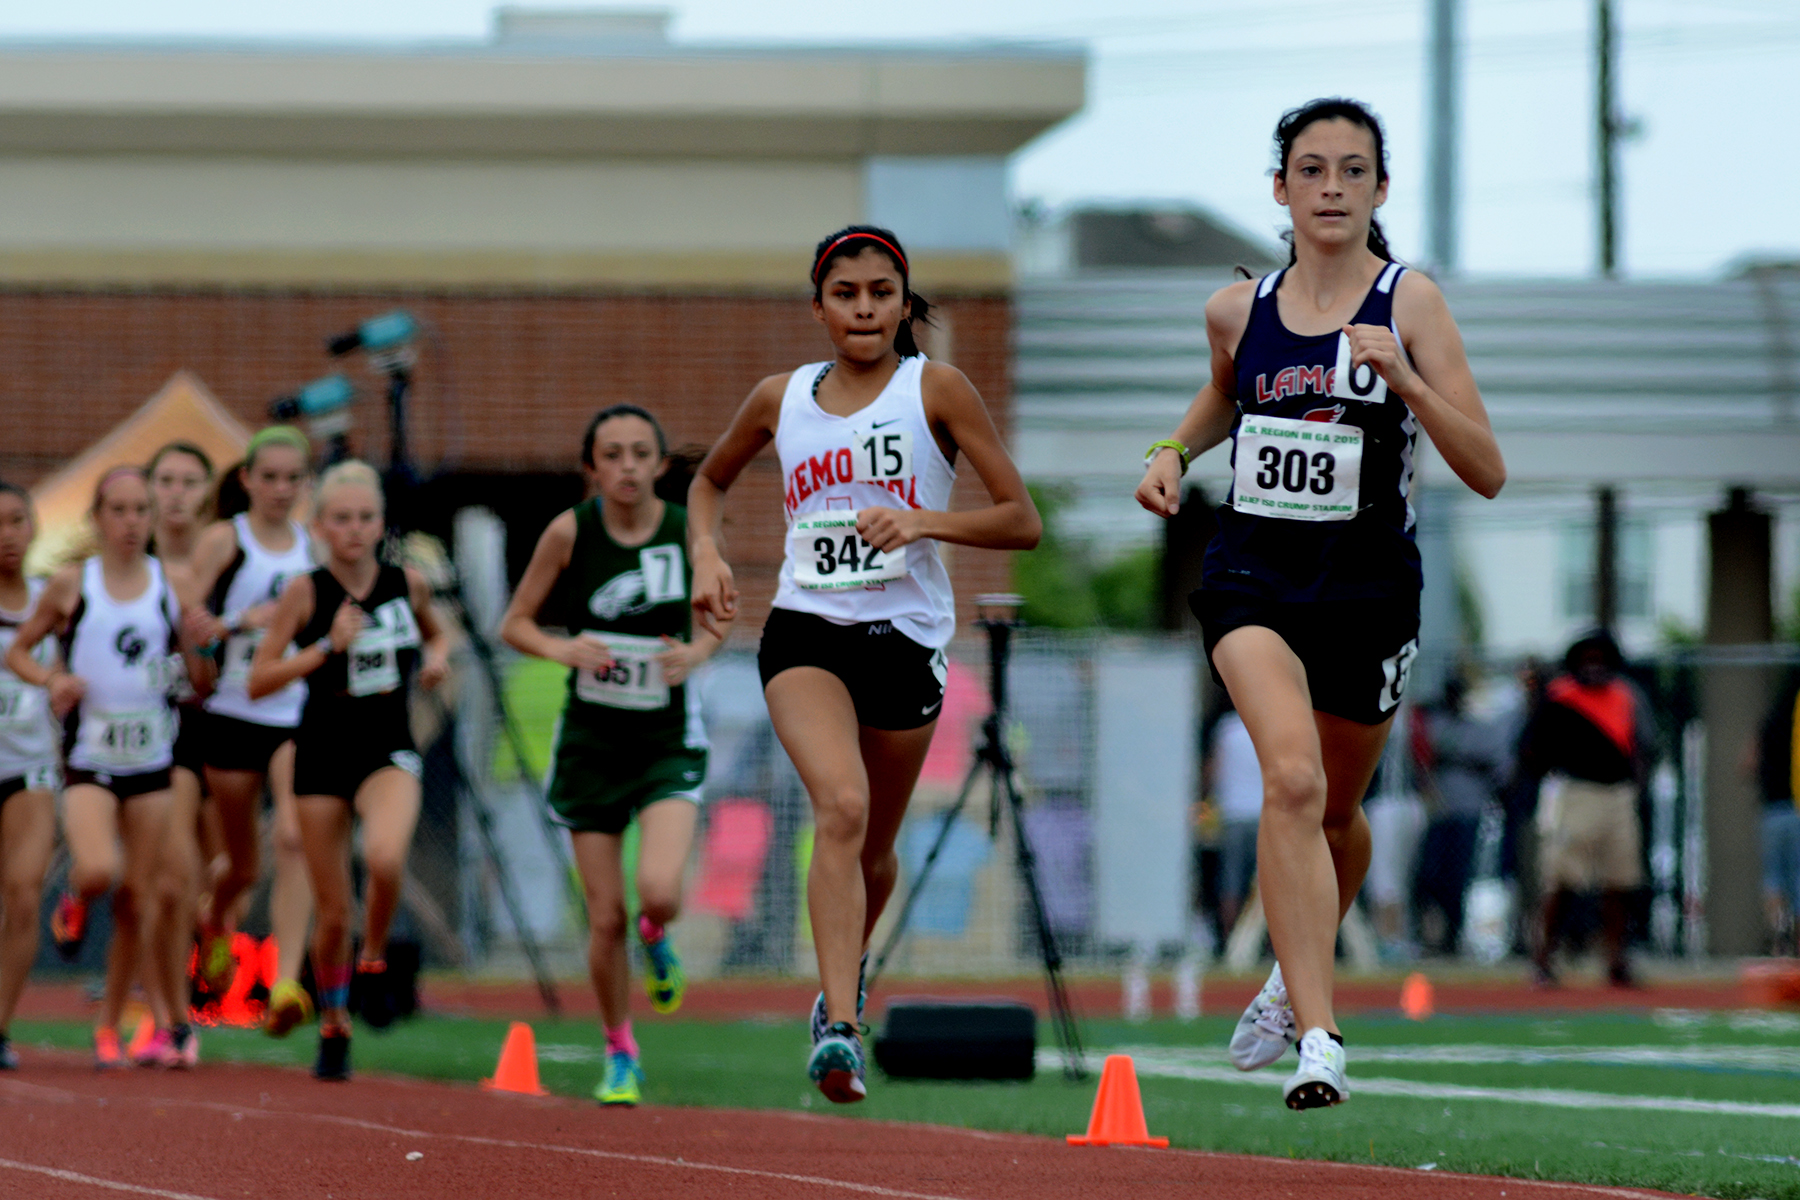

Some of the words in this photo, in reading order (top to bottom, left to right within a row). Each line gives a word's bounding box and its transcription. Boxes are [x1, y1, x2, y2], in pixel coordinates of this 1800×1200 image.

[863, 434, 903, 477] 15
[1260, 427, 1299, 439] REGION
[1333, 435, 1360, 445] 2015
[1256, 445, 1336, 496] 303
[812, 520, 846, 529] REGION
[1277, 501, 1310, 511] CRUMP
[1312, 504, 1353, 512] STADIUM
[652, 552, 672, 594] 7
[814, 535, 884, 575] 342
